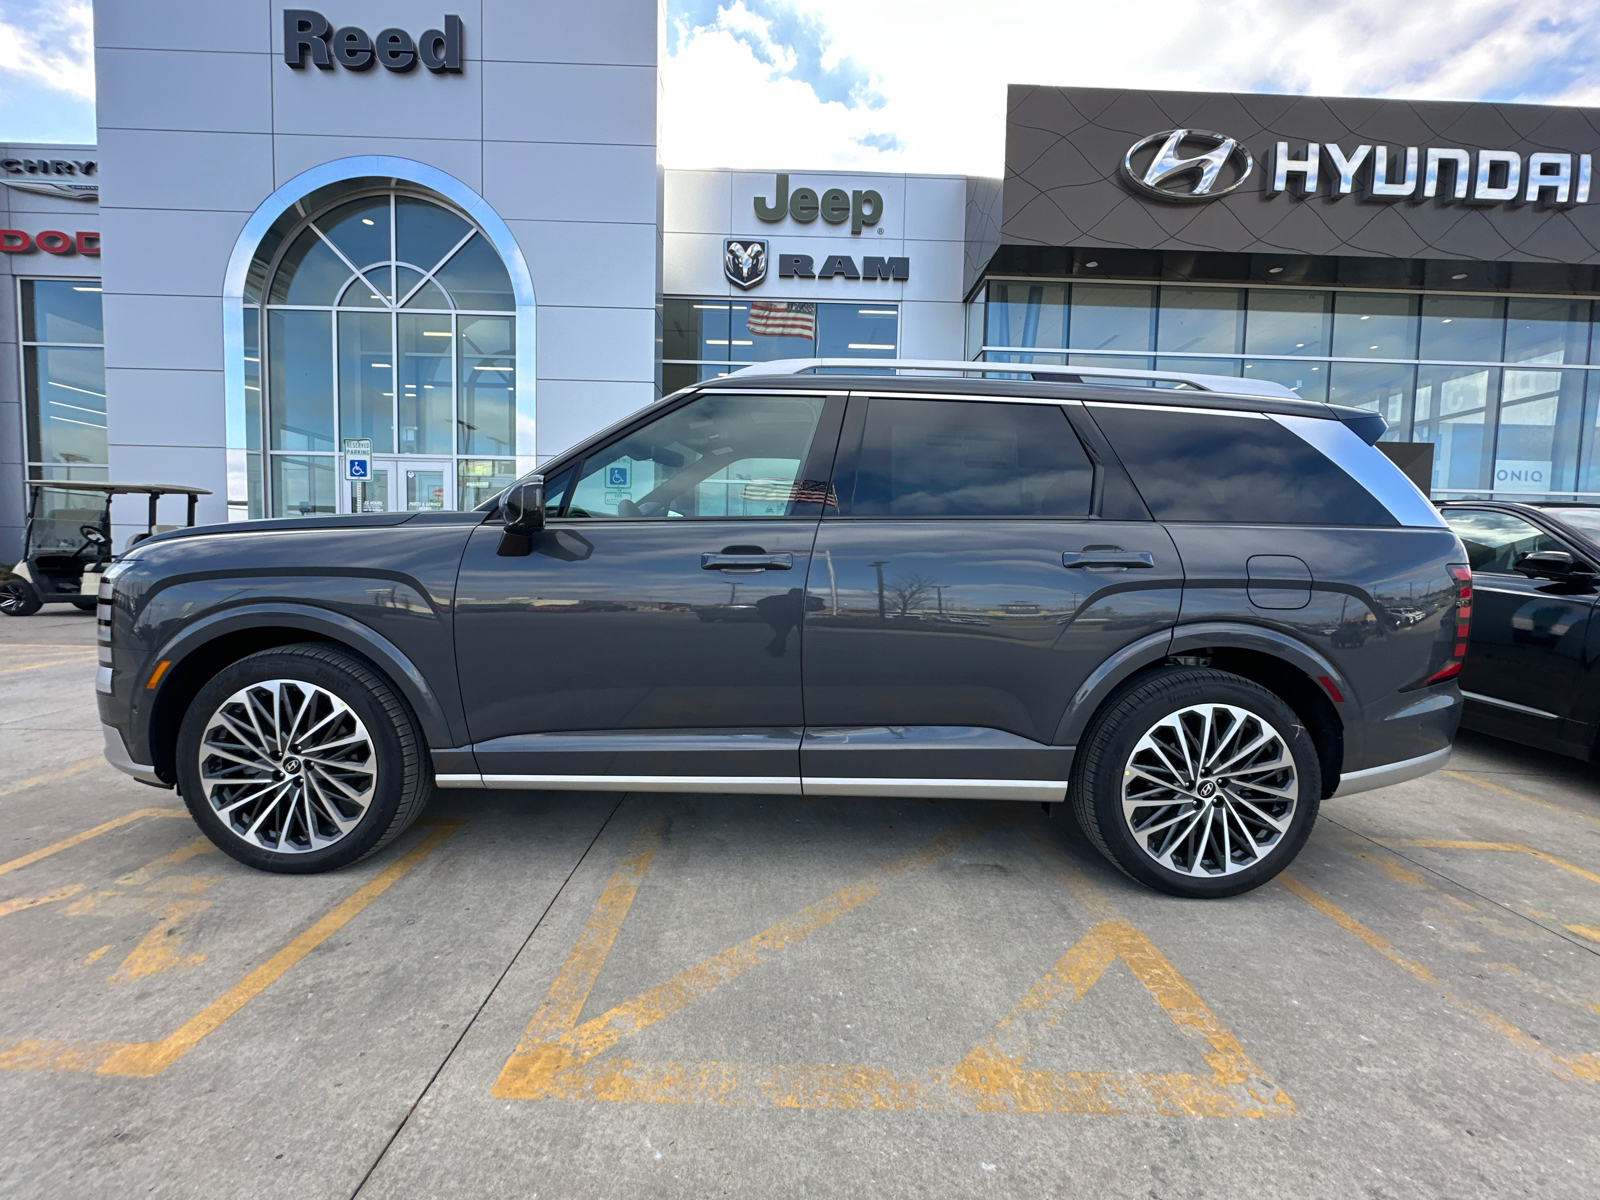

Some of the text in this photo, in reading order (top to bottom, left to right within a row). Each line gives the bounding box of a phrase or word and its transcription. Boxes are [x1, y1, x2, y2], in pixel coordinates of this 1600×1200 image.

[284, 9, 461, 71] Reed
[0, 159, 98, 175] CHRY
[1272, 141, 1592, 203] HYUNDAI
[0, 229, 100, 253] DOD
[779, 254, 910, 280] RAM
[1496, 469, 1542, 482] ONIQ
